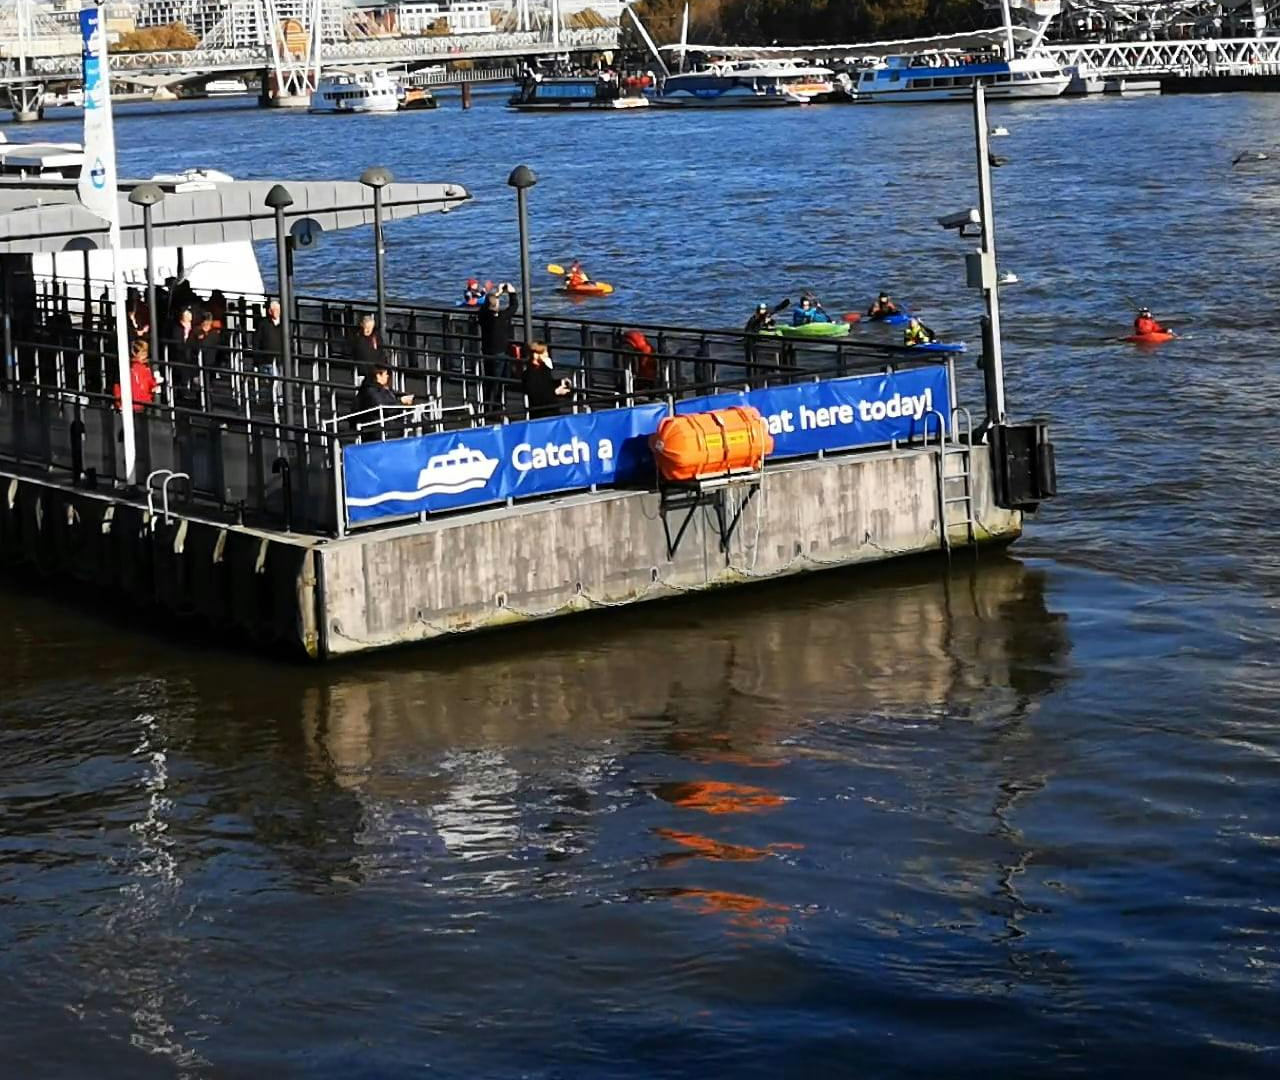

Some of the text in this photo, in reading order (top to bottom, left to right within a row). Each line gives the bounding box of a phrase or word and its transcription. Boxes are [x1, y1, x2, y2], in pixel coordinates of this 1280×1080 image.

[511, 435, 591, 471] Catch
[597, 438, 613, 460] a
[799, 404, 854, 431] here
[858, 387, 933, 421] today!
